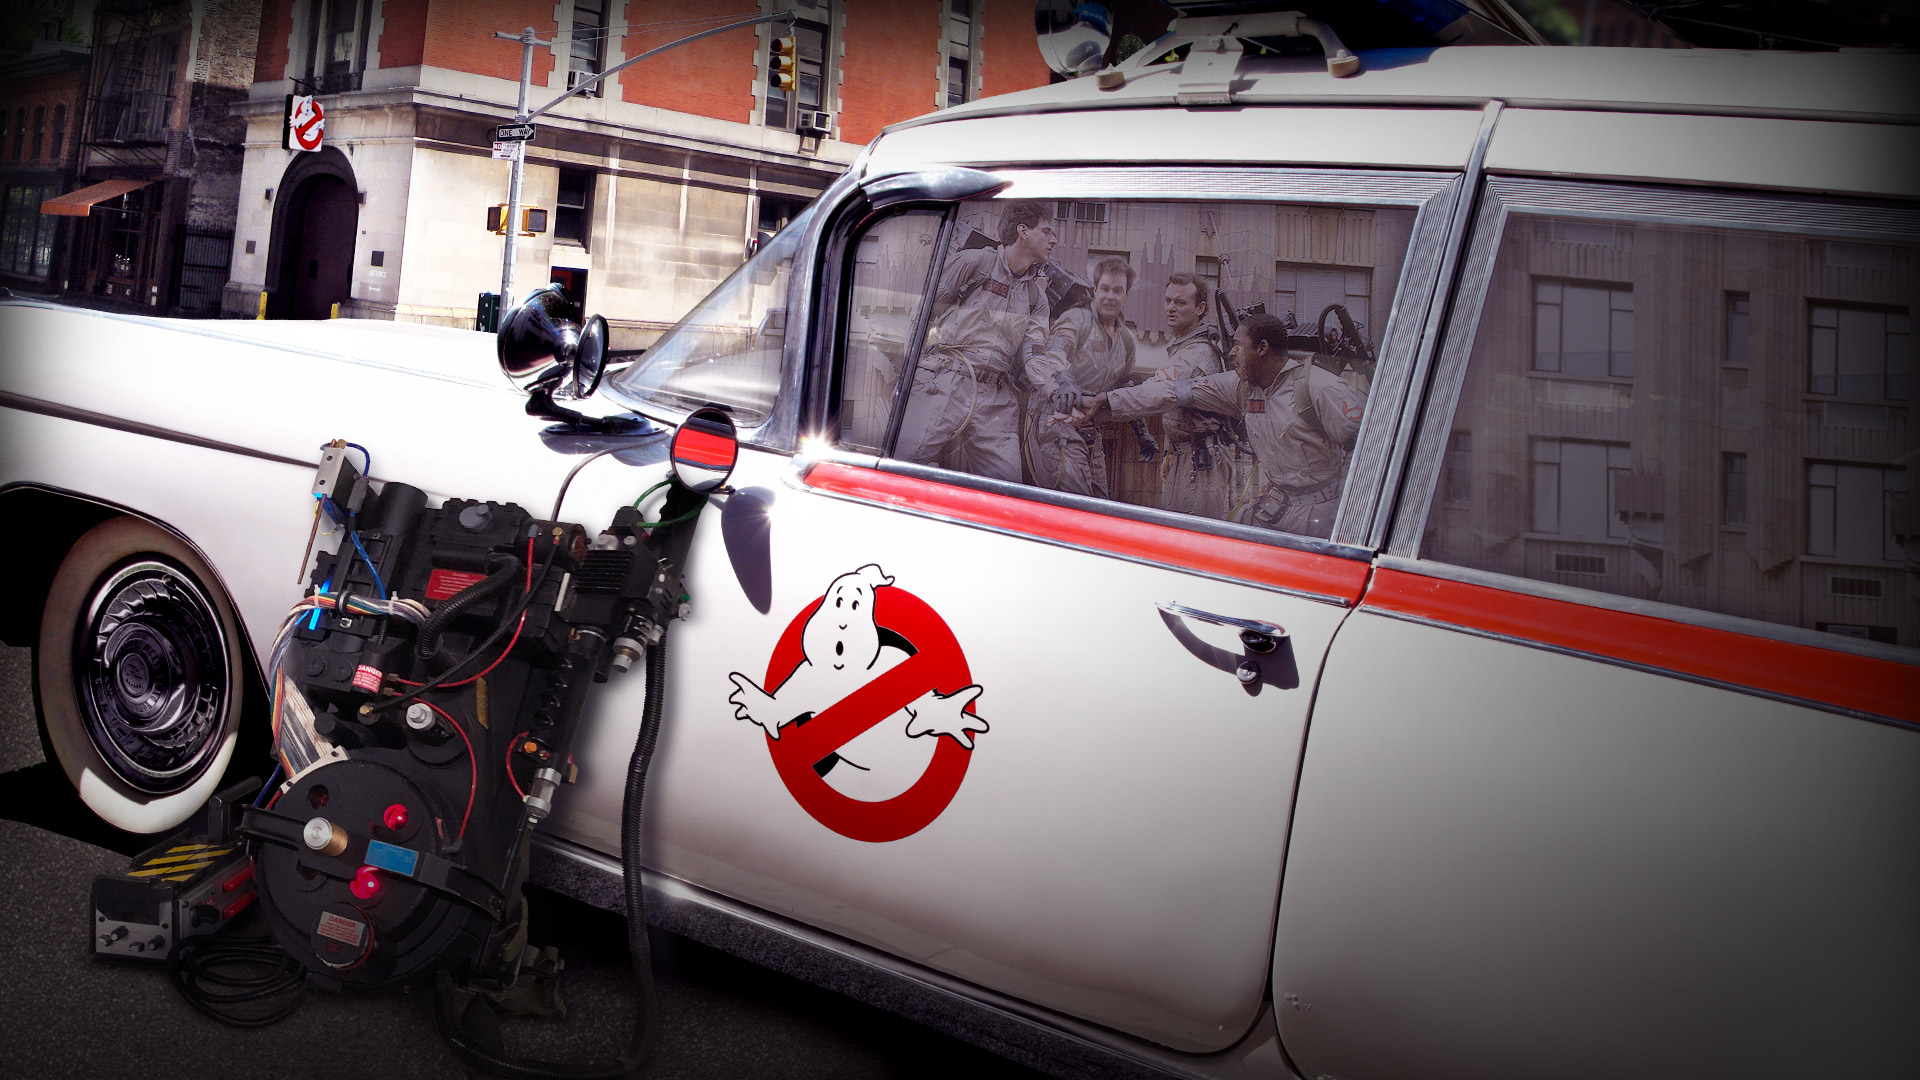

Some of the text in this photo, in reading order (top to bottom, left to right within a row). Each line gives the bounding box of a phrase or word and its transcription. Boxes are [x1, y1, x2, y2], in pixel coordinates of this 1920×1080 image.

[500, 129, 512, 137] ONE
[357, 664, 383, 679] DANGER
[328, 915, 356, 928] DANGER
